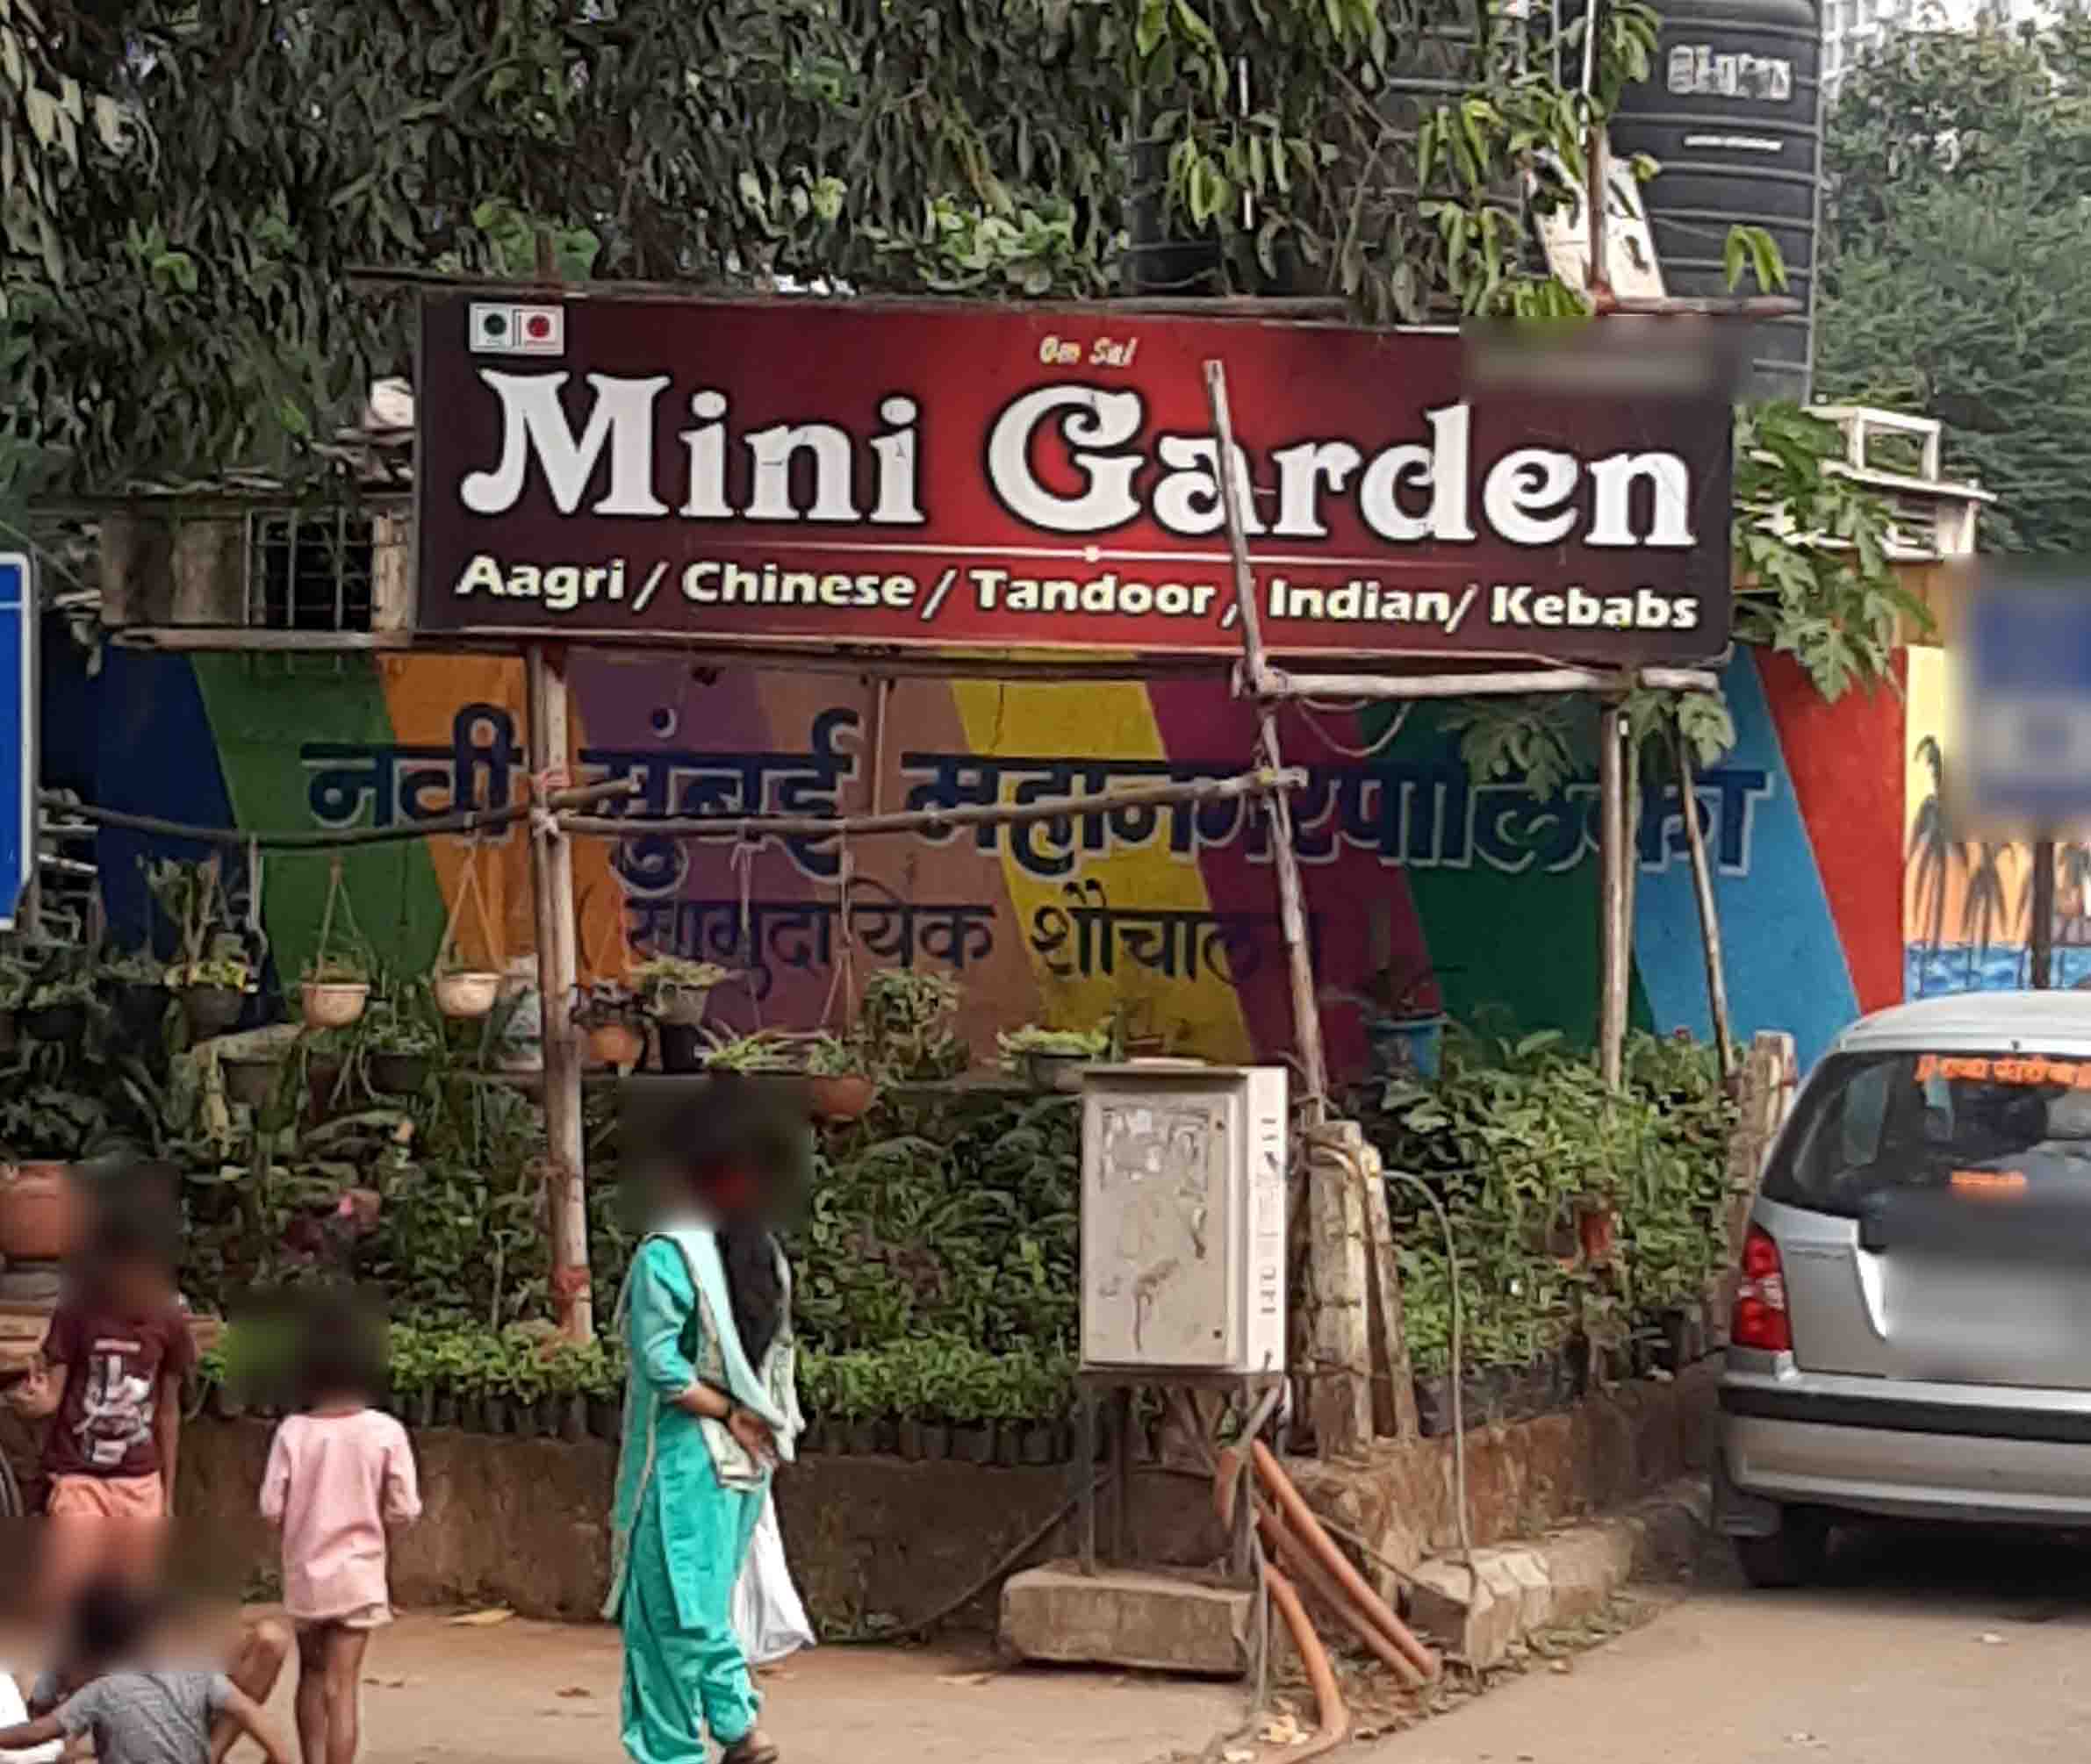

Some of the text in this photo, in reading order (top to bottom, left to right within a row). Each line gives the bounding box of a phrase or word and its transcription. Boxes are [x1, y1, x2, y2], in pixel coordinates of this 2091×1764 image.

[460, 368, 1698, 547] Mini Garden
[455, 555, 625, 610] Aagri
[681, 561, 916, 606] Chinese
[969, 569, 1217, 615] Tandoor
[1490, 584, 1699, 628] Kebabs
[299, 702, 524, 845] नवी
